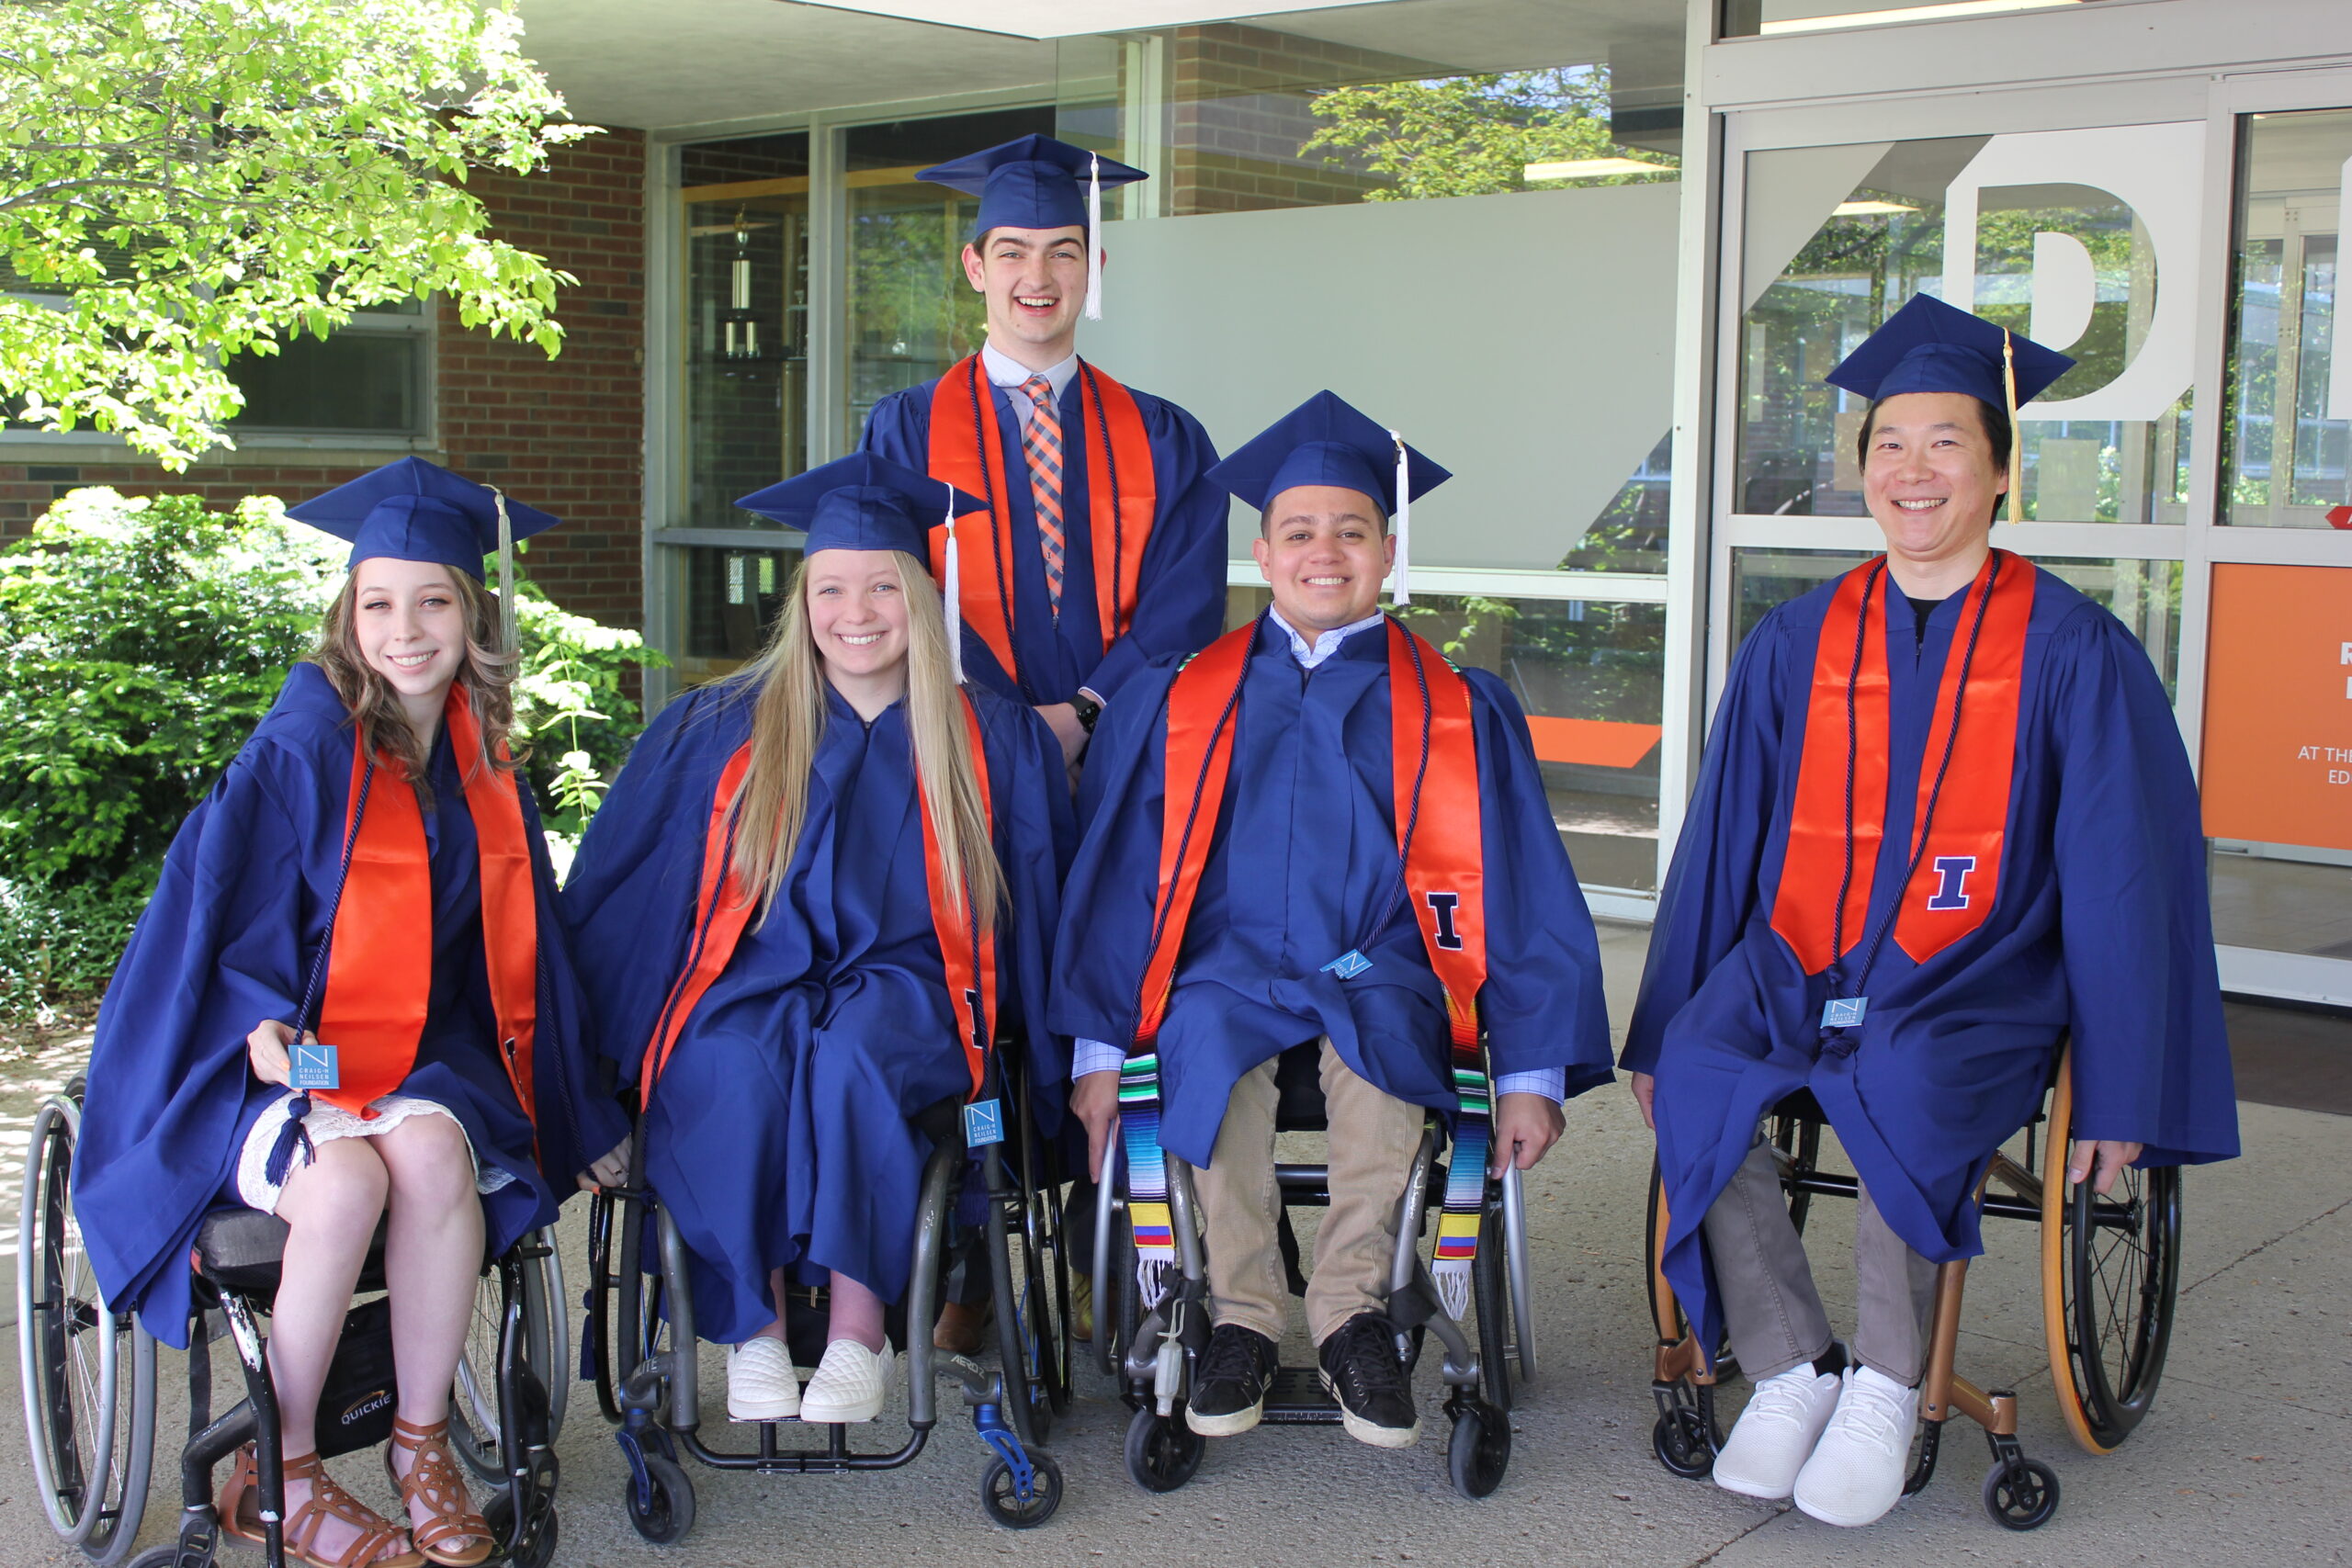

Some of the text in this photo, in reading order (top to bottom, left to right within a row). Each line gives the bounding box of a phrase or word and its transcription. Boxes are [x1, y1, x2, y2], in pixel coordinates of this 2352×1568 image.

[2297, 745, 2321, 761] AT
[2328, 769, 2352, 784] ED
[1927, 856, 1976, 910] I
[1426, 891, 1464, 951] I
[1831, 998, 1860, 1013] N
[298, 1046, 329, 1068] N
[970, 1103, 995, 1125] N
[341, 1393, 392, 1425] QUICKIE
